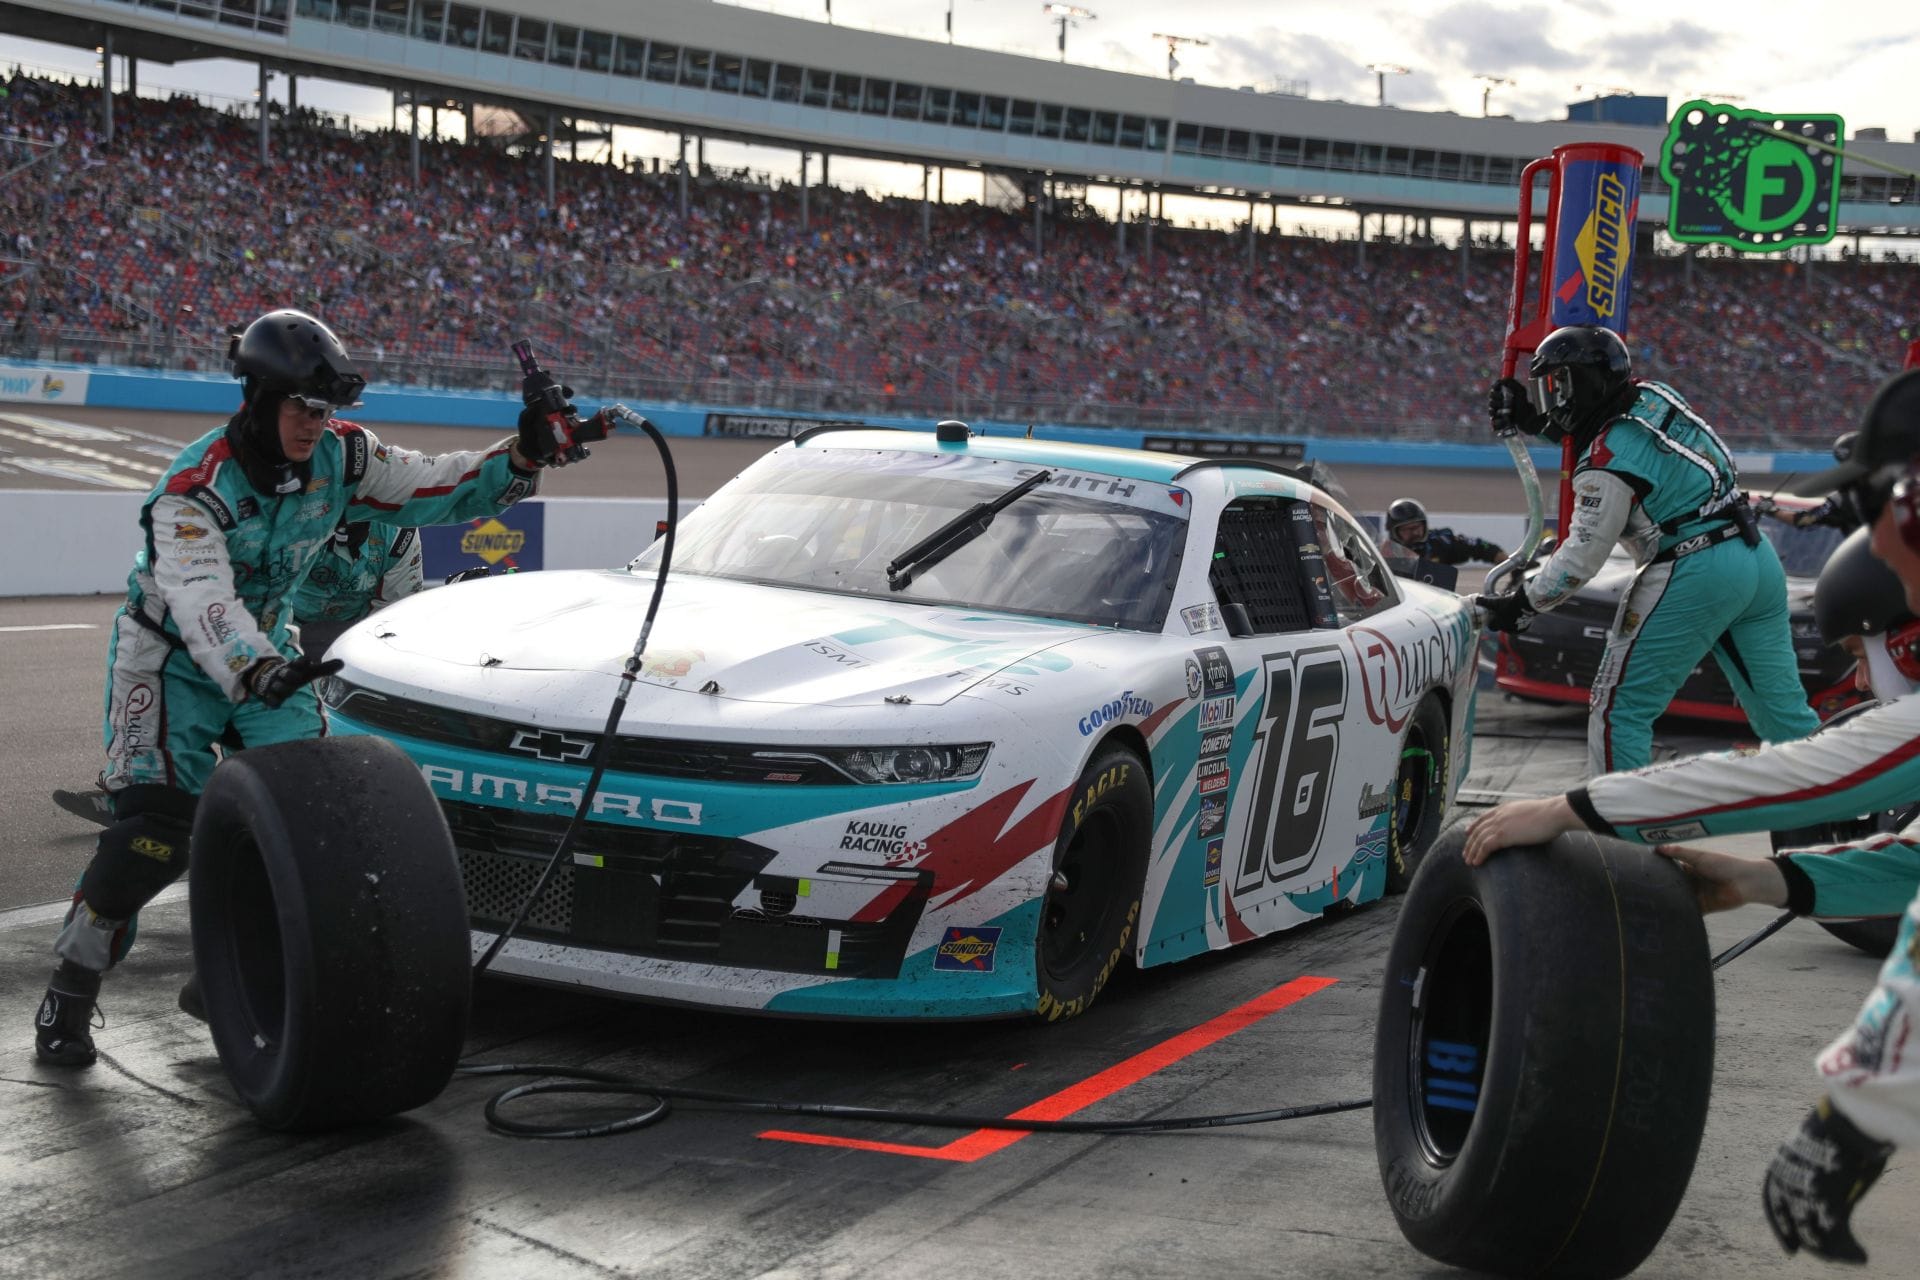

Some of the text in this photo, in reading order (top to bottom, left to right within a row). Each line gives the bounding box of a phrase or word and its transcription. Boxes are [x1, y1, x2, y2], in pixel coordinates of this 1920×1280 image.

[1590, 177, 1625, 314] SUNOCO
[0, 376, 37, 395] WAY
[464, 533, 522, 551] SUNOCO
[1079, 691, 1154, 737] GOODYEAR
[1200, 699, 1225, 725] Mobil
[1200, 734, 1232, 754] COMETIC
[1198, 761, 1226, 778] LINCOLN
[1234, 644, 1349, 898] 16
[422, 764, 703, 827] AMARO
[1073, 764, 1130, 829] EAGLE
[846, 821, 907, 839] KAULIG
[839, 836, 904, 854] RACING
[942, 942, 990, 955] SUNOCO
